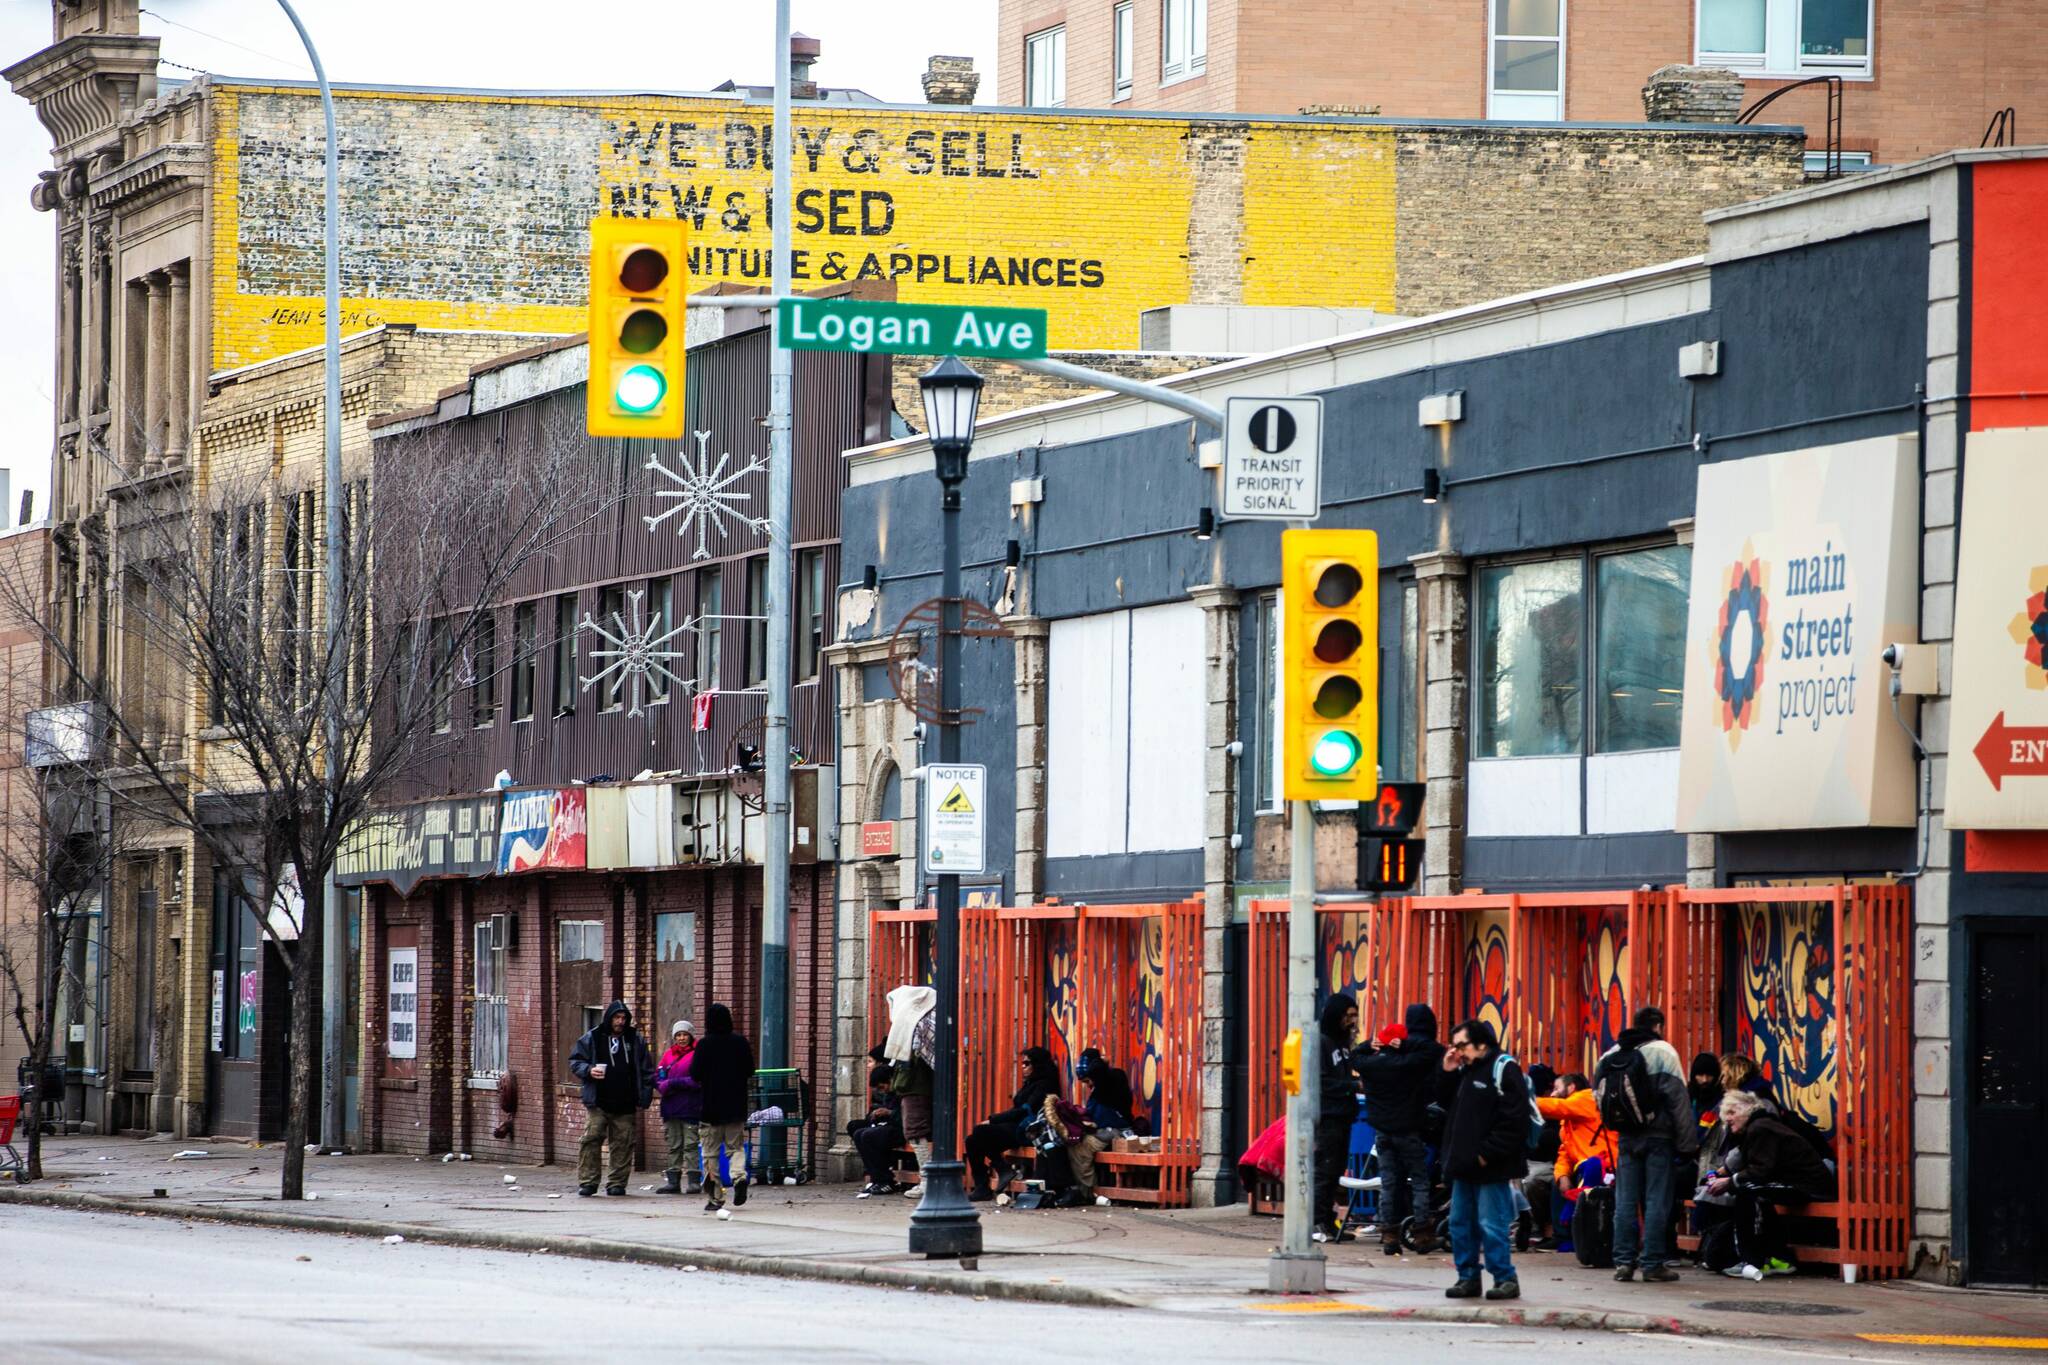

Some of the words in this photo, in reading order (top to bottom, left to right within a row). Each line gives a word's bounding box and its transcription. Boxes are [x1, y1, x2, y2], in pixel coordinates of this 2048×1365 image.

[610, 121, 697, 169] WE
[843, 128, 881, 174] &
[906, 129, 1041, 179] SELL
[721, 191, 752, 233] &
[687, 246, 810, 280] NITUE
[820, 251, 848, 281] &
[856, 252, 1105, 288] APPLIANCES
[318, 309, 360, 327] SGN
[792, 304, 931, 351] Logan
[953, 311, 1033, 349] Ave
[1236, 476, 1304, 492] PRIORITY
[1241, 458, 1302, 473] TRANSIT
[1243, 495, 1297, 510] SIGNAL
[1786, 540, 1846, 597] main
[1781, 603, 1853, 661] street
[1776, 664, 1857, 735] project
[2009, 739, 2048, 763] EN
[936, 769, 977, 780] NOTICE
[394, 822, 425, 870] Hotel
[1382, 843, 1406, 883] 11
